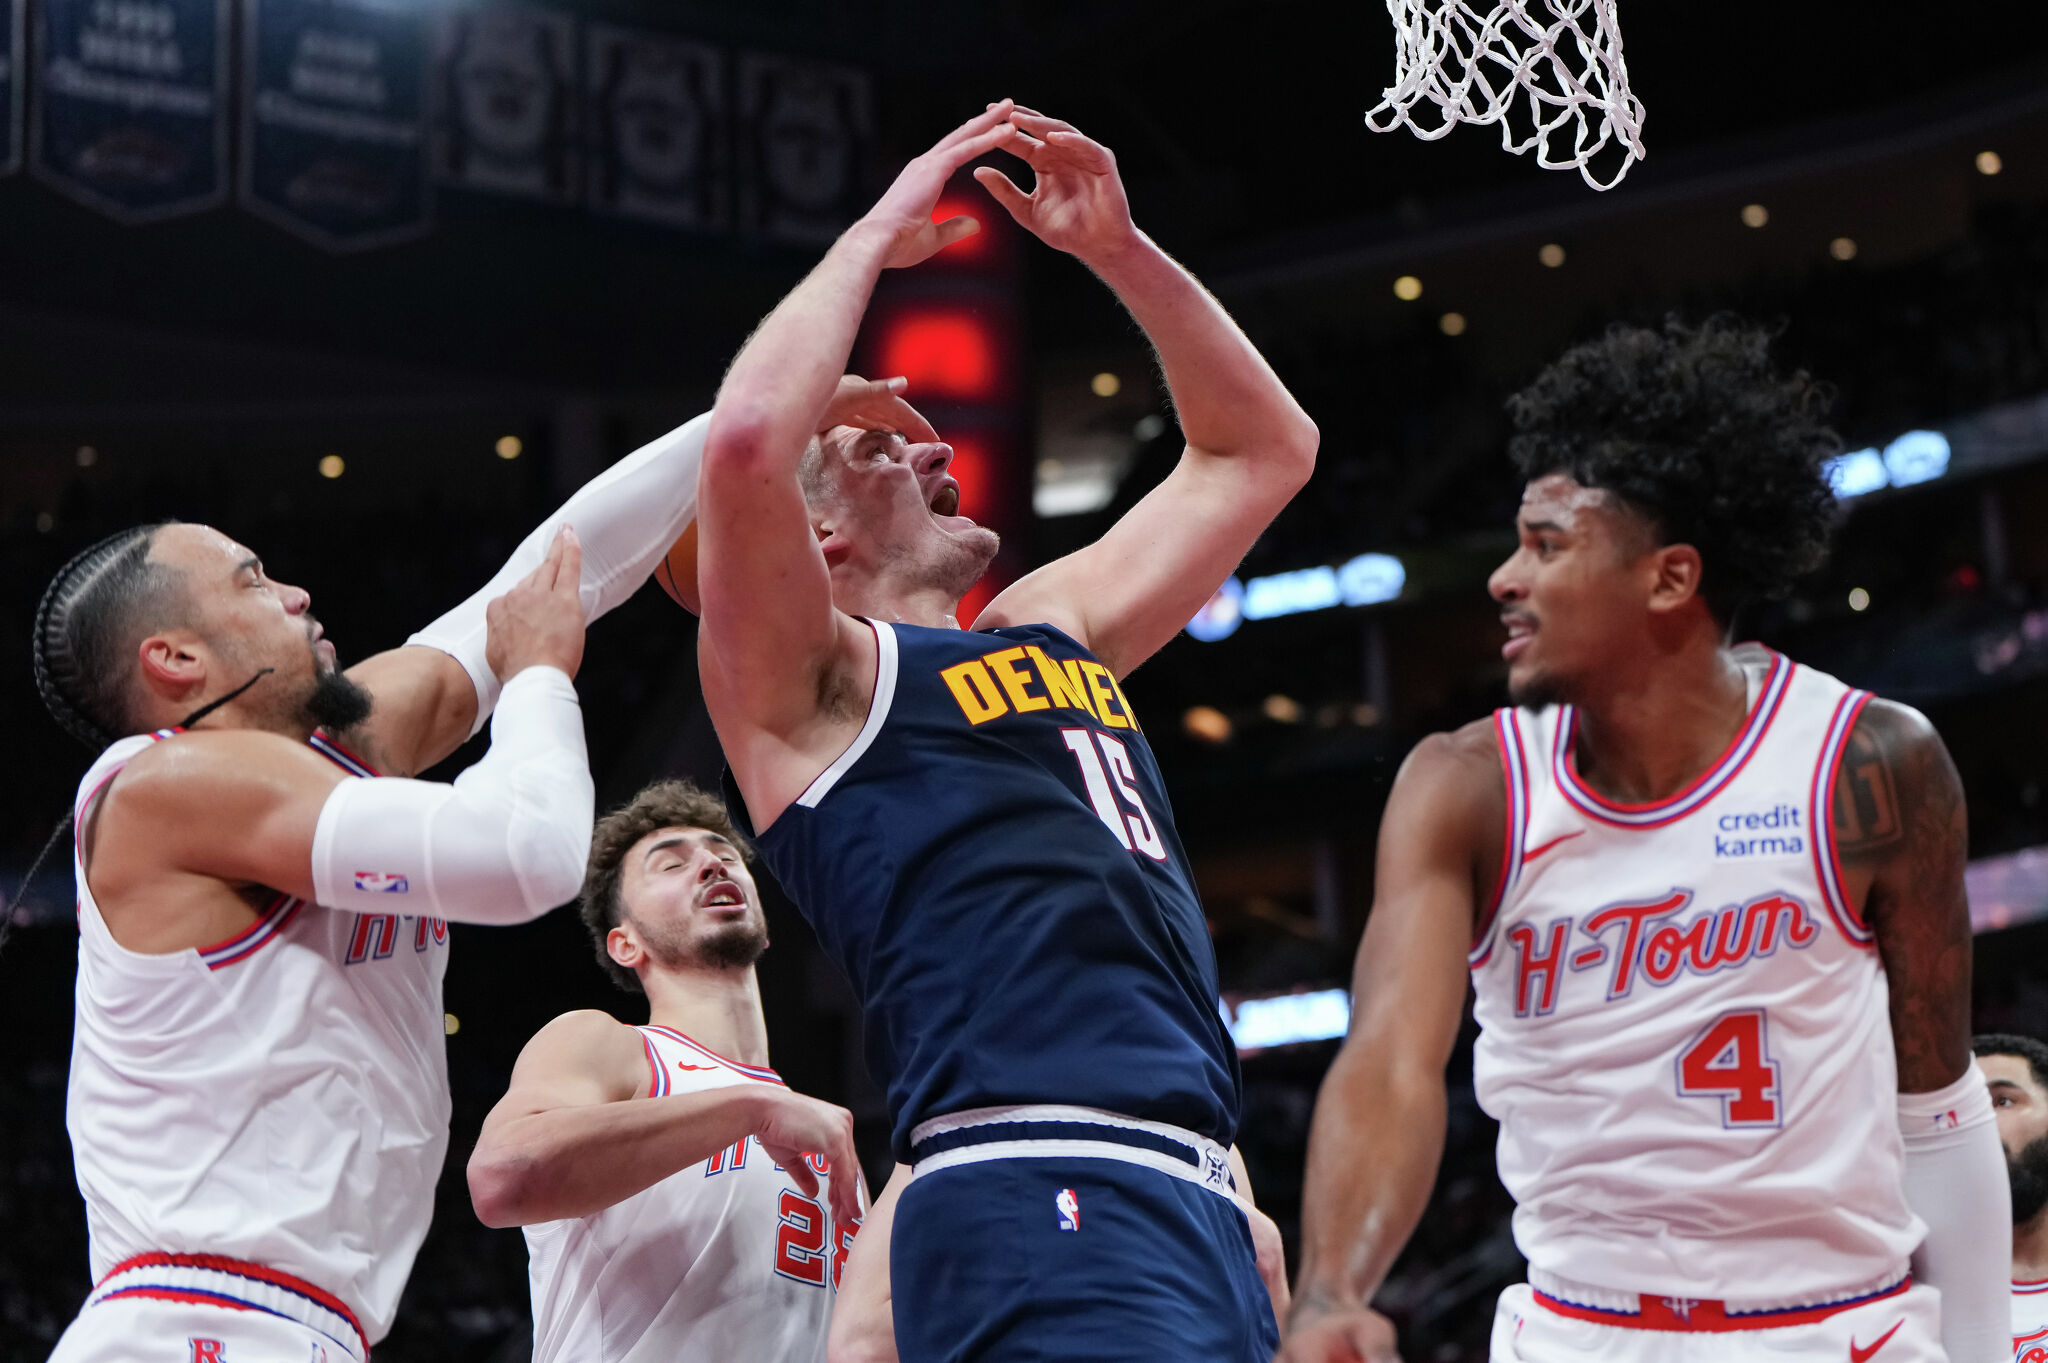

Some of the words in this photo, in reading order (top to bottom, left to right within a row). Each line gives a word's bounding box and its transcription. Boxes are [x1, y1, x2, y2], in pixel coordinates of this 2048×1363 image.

[1058, 727, 1168, 862] 15
[1715, 834, 1803, 857] karma
[1718, 805, 1800, 831] credit
[1505, 887, 1821, 1018] H-Town
[1675, 1007, 1783, 1129] 4
